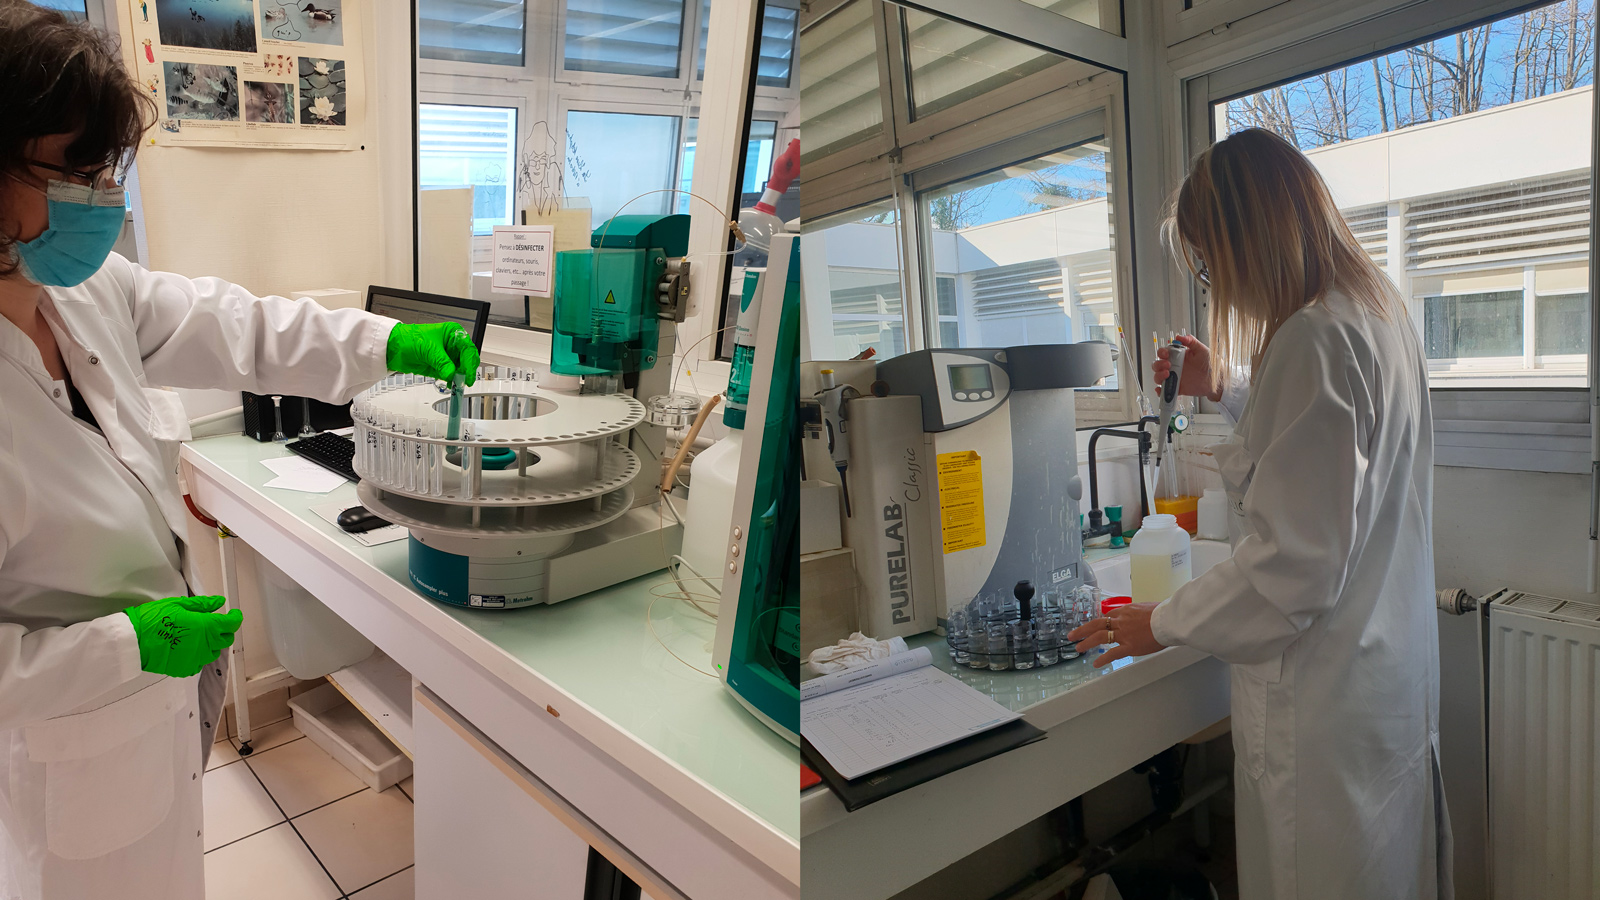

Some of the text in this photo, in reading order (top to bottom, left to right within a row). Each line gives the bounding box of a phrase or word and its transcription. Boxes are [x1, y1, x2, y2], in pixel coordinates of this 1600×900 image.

[516, 243, 544, 252] DÉSINFECTER
[902, 447, 922, 502] Classic
[883, 504, 910, 625] PURELAB
[1052, 568, 1071, 580] ELGA
